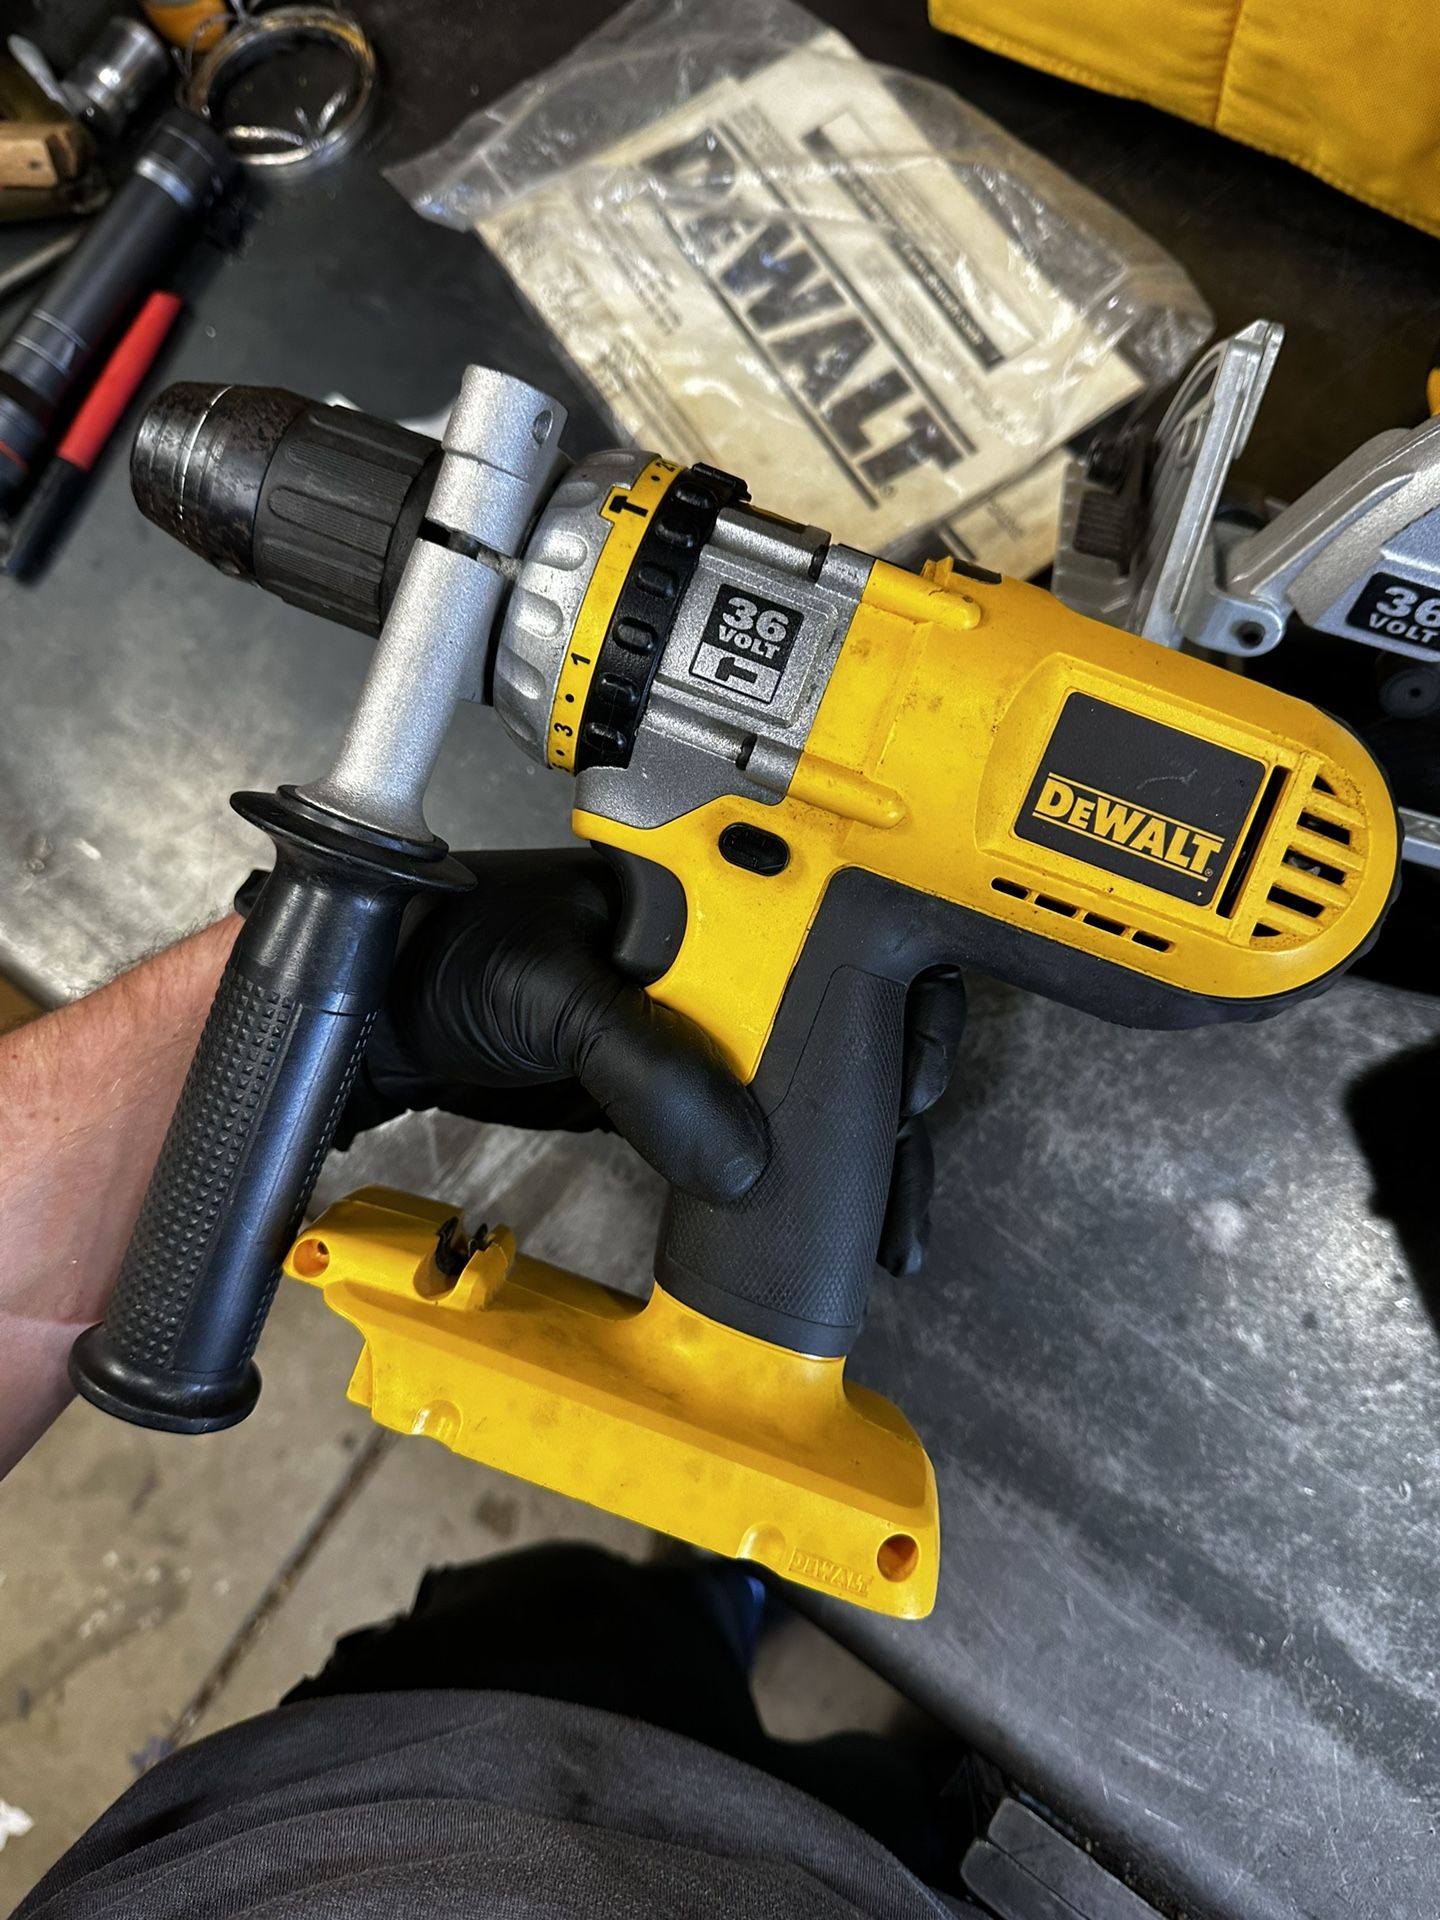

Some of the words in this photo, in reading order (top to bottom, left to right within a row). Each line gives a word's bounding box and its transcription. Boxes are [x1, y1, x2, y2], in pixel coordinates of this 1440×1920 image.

[722, 597, 790, 643] 36
[1376, 586, 1440, 628] 36
[718, 624, 781, 660] VOLT
[1368, 613, 1439, 643] VOLT
[570, 652, 592, 666] 1
[553, 722, 574, 737] 3
